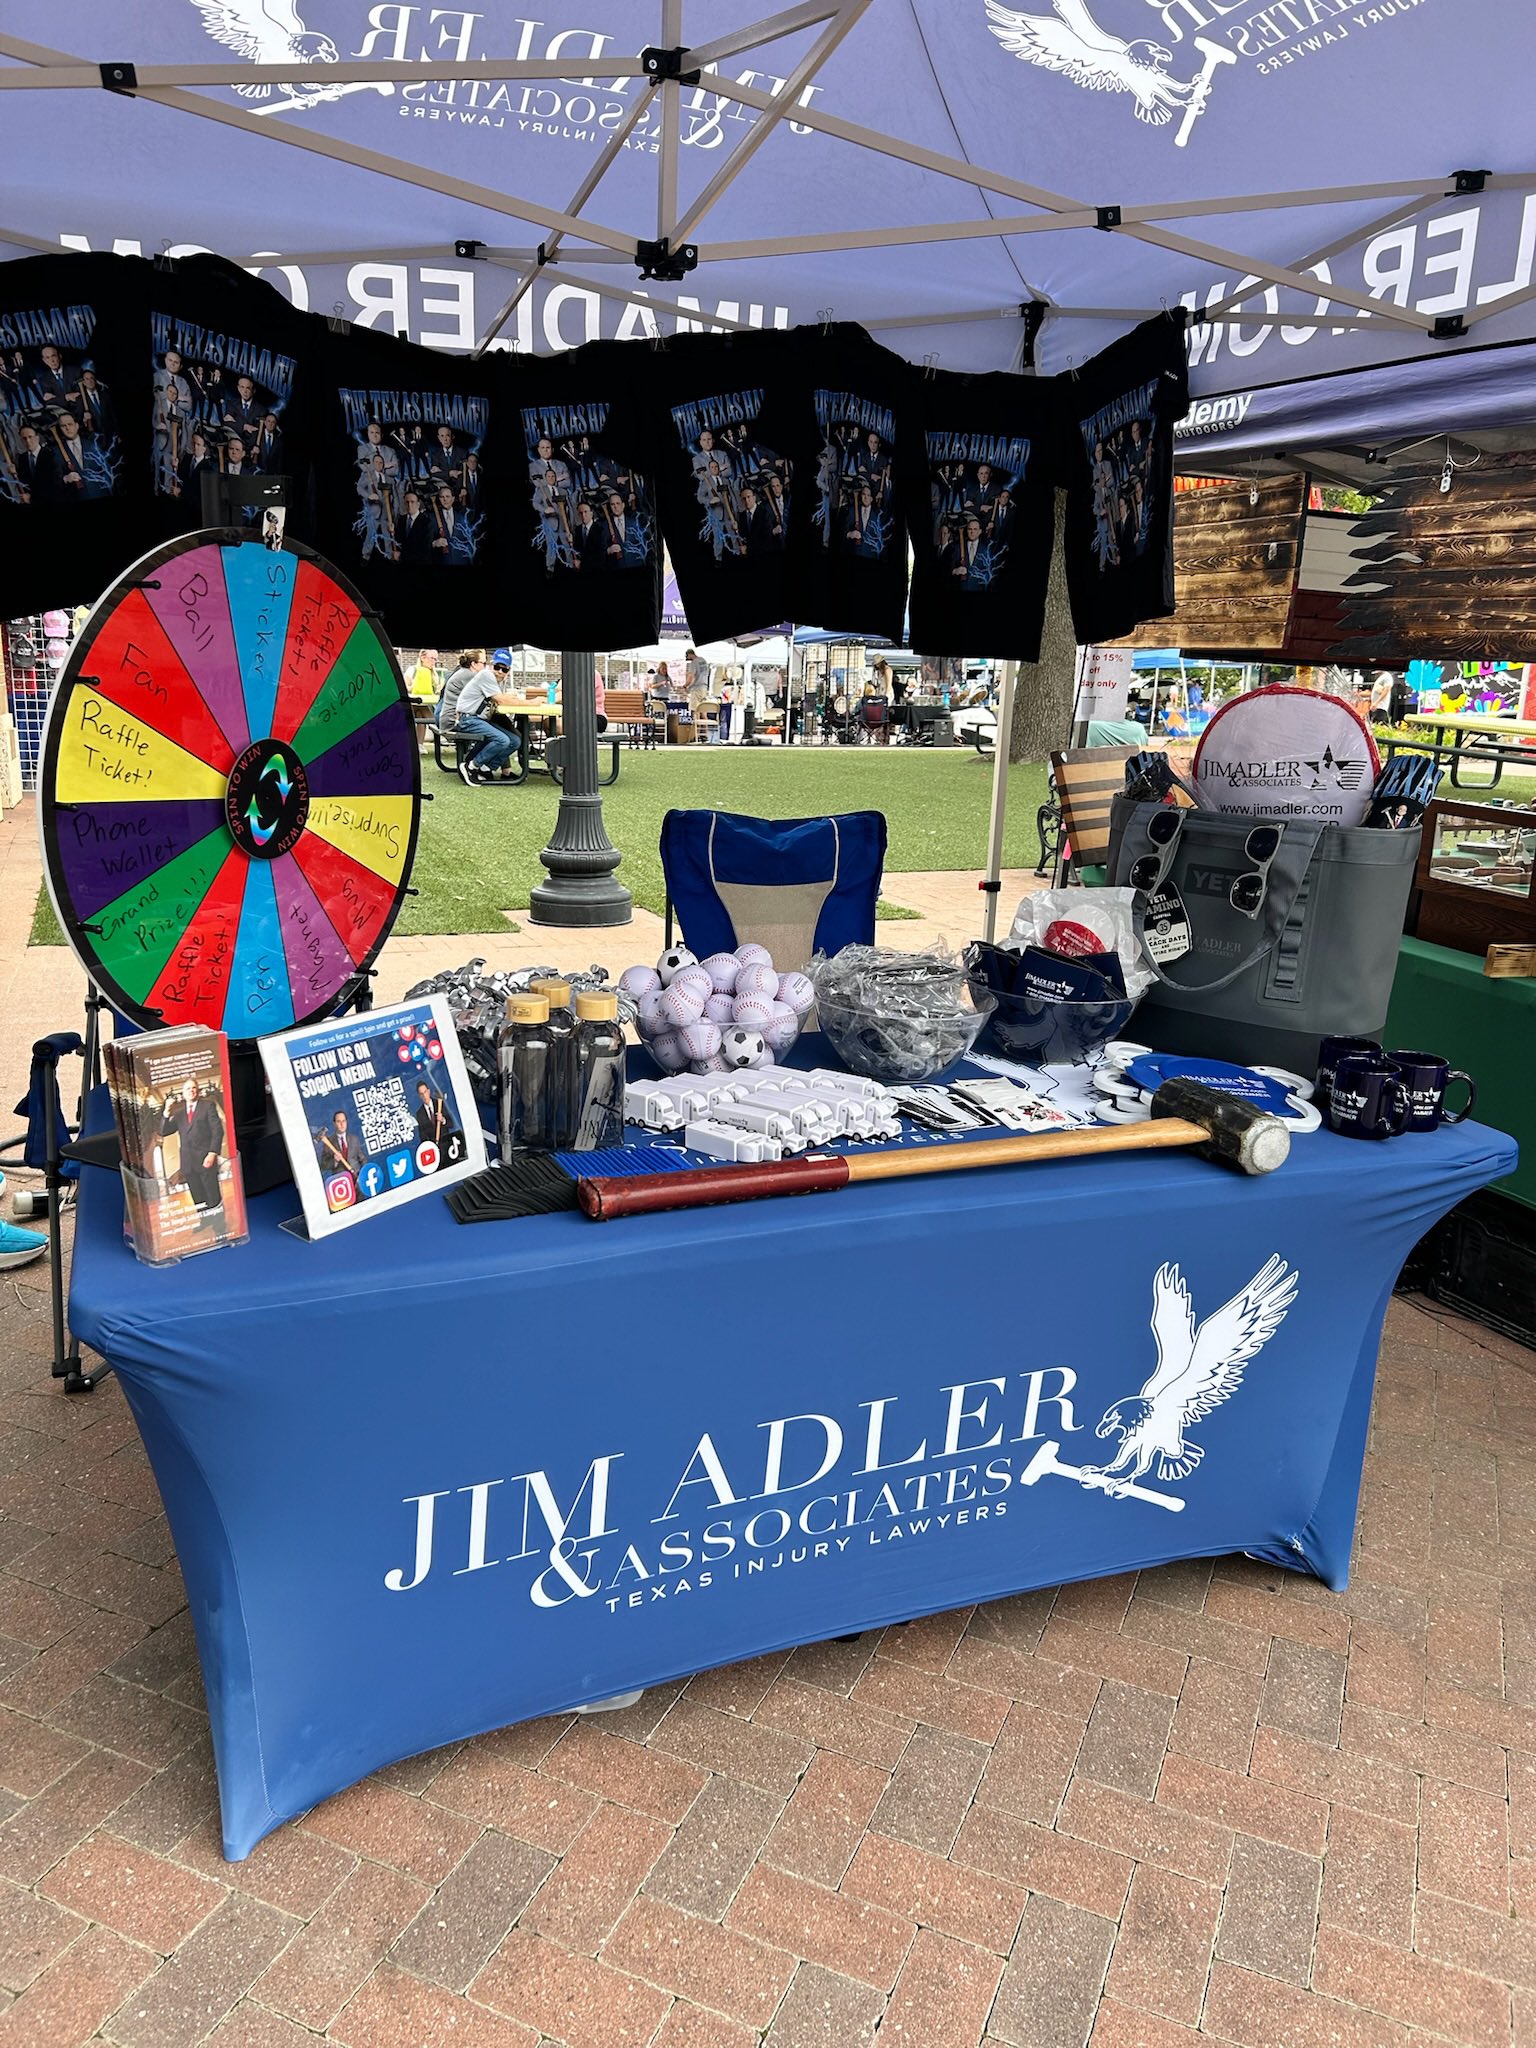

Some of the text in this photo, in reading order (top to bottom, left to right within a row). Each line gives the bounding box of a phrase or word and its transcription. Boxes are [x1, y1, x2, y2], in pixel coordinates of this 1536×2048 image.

[174, 317, 226, 366] TEXAS
[338, 388, 369, 433] THE
[369, 390, 421, 424] TEXAS
[538, 403, 588, 440] TEXAS
[671, 401, 702, 448] THE
[697, 393, 745, 430] TEXAS
[1176, 419, 1235, 439] OUTDOORS
[926, 431, 969, 462] TEXAS
[178, 572, 214, 652] Ball
[254, 565, 287, 679] Sticker
[310, 602, 350, 671] Raffle
[120, 642, 168, 704] Fan
[1089, 666, 1101, 674] off
[1092, 653, 1101, 661] to
[1103, 653, 1124, 663] 15%
[318, 662, 382, 723] Koozie
[1097, 680, 1117, 689] only
[80, 699, 150, 756] Raffle
[83, 744, 153, 788] Ticket!
[229, 745, 262, 835] SPIN TO WIN
[1228, 771, 1302, 788] & ASSOCIATES
[73, 811, 153, 848] Phone
[277, 766, 308, 853] SPIN TO WIN
[1220, 803, 1343, 817] www.jimadler.com
[101, 836, 179, 877] Wallet
[100, 884, 160, 942] Grand
[342, 878, 378, 931] Mug
[1159, 922, 1168, 932] 35
[193, 914, 231, 1008] Ticket!
[290, 904, 332, 991] Magnet
[1168, 934, 1187, 943] DAYS
[161, 934, 206, 1003] Raffle
[247, 955, 273, 1014] Pen
[308, 1035, 330, 1048] Follow
[328, 1035, 335, 1043] us
[335, 1032, 345, 1042] for
[363, 1024, 376, 1034] Spin
[375, 1020, 387, 1031] and
[387, 1018, 397, 1029] get
[292, 1041, 371, 1078] FOLLOW US ON
[299, 1061, 376, 1099] SOCIAL MEDIA
[384, 1366, 1085, 1592] JIM ADLER
[604, 1458, 1013, 1592] ASSOCIATES
[607, 1502, 1008, 1614] TEXAS INJURY LAWYERS
